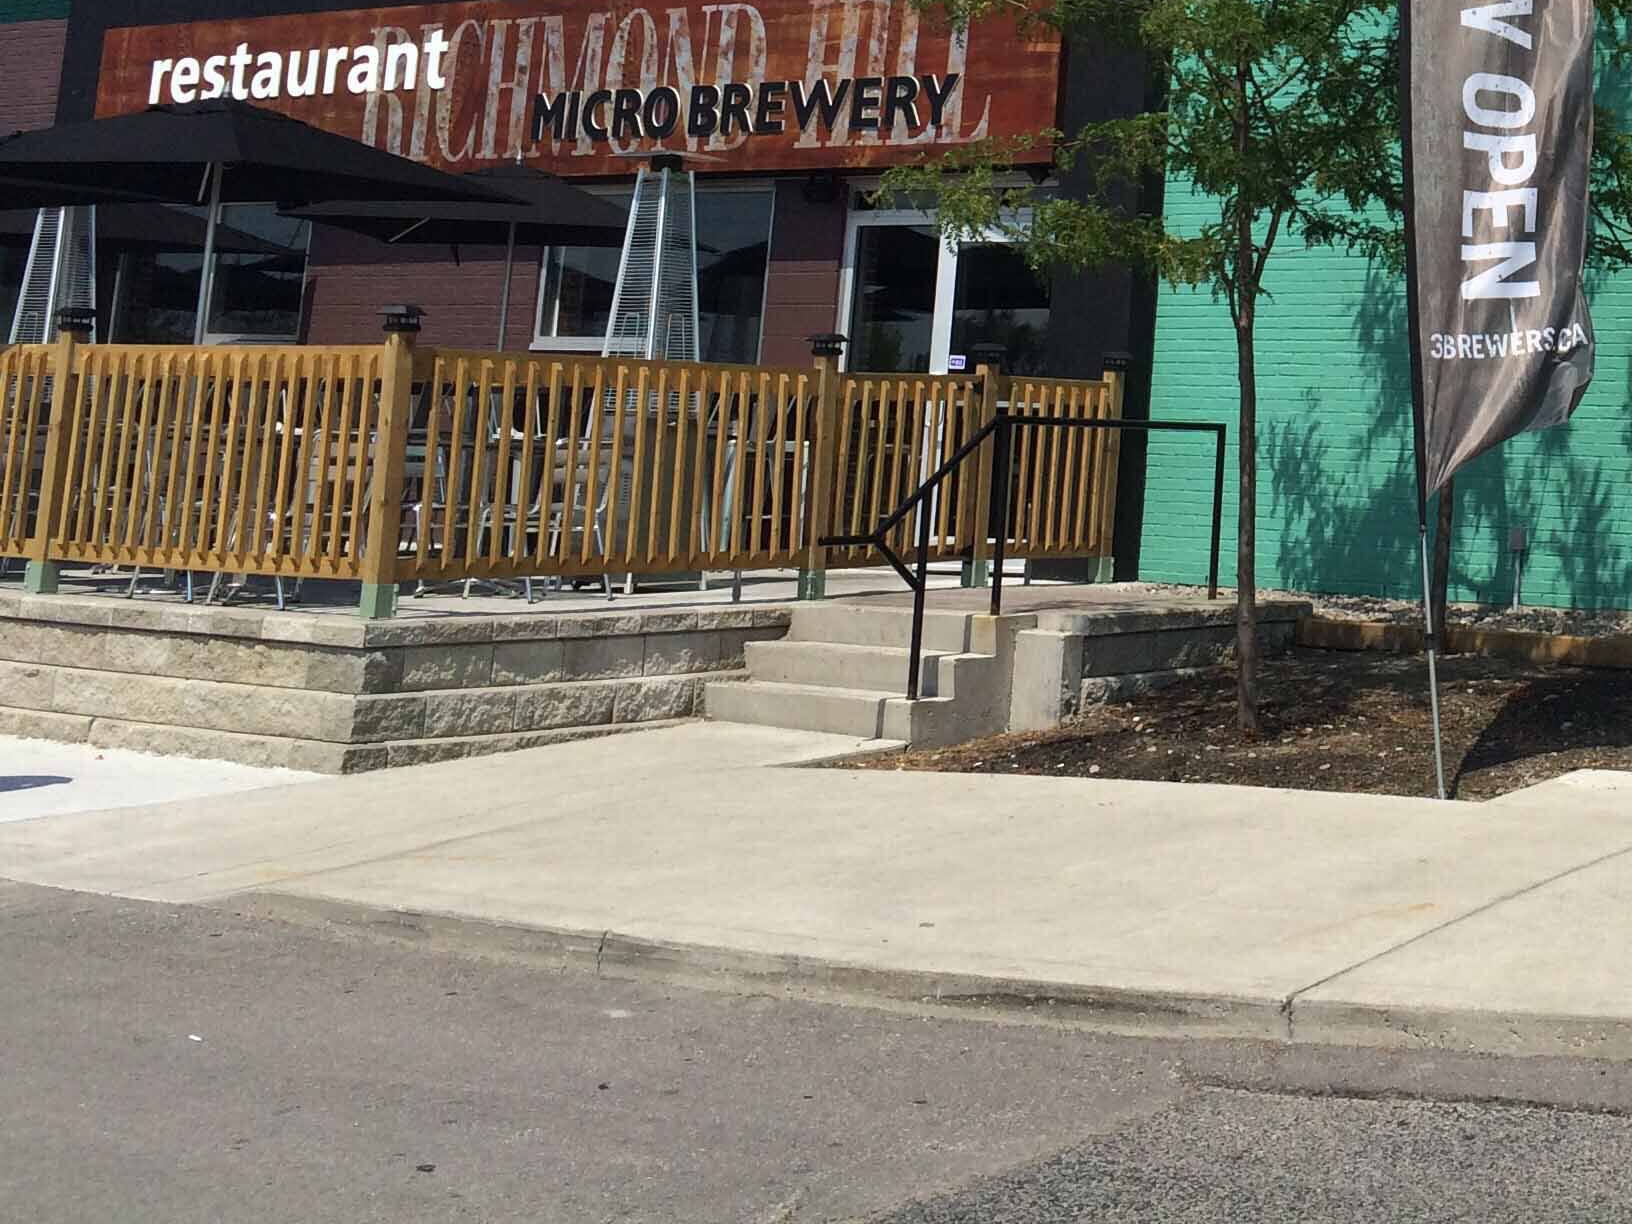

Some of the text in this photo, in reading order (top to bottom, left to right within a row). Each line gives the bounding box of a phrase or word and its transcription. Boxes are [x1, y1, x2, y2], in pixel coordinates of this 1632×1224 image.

[147, 29, 449, 105] restaurant
[361, 2, 767, 162] RICHMOND
[530, 72, 962, 142] MICRO BREWERY
[1462, 72, 1542, 301] OPEN
[1430, 322, 1589, 360] 3BREWERS.CA
